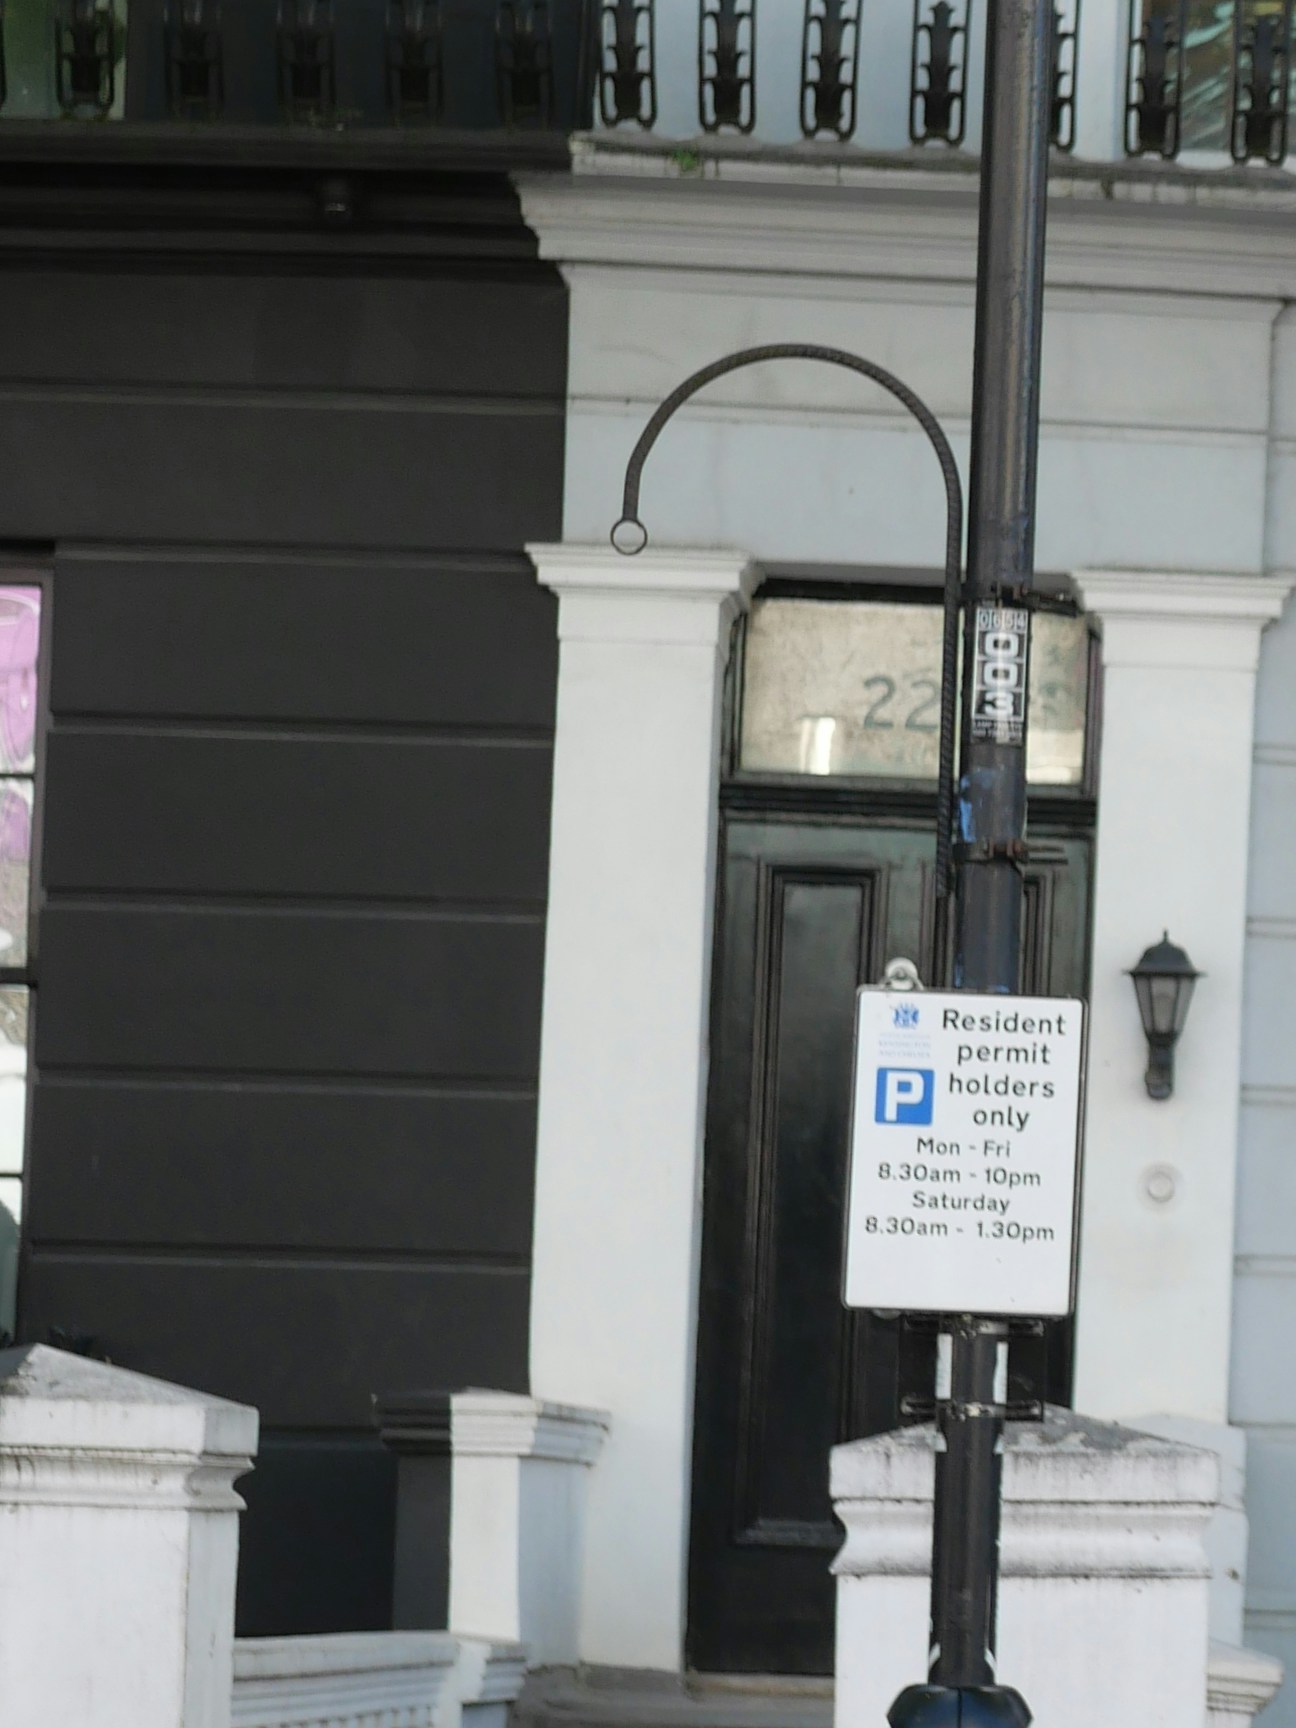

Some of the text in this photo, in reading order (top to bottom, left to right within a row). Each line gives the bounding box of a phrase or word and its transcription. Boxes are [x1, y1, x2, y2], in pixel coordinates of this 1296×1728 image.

[942, 1008, 1067, 1036] Resident
[957, 1042, 1051, 1067] permit
[884, 1070, 925, 1122] P
[949, 1072, 1055, 1099] holders
[973, 1106, 1030, 1132] only
[916, 1137, 960, 1156] Mon
[983, 1139, 1011, 1158] Fri
[878, 1162, 961, 1184] 8.30am
[985, 1167, 1041, 1189] 10pm
[912, 1190, 1011, 1216] Saturday
[865, 1216, 948, 1237] 8.30am
[977, 1221, 1055, 1244] 1.30pm
